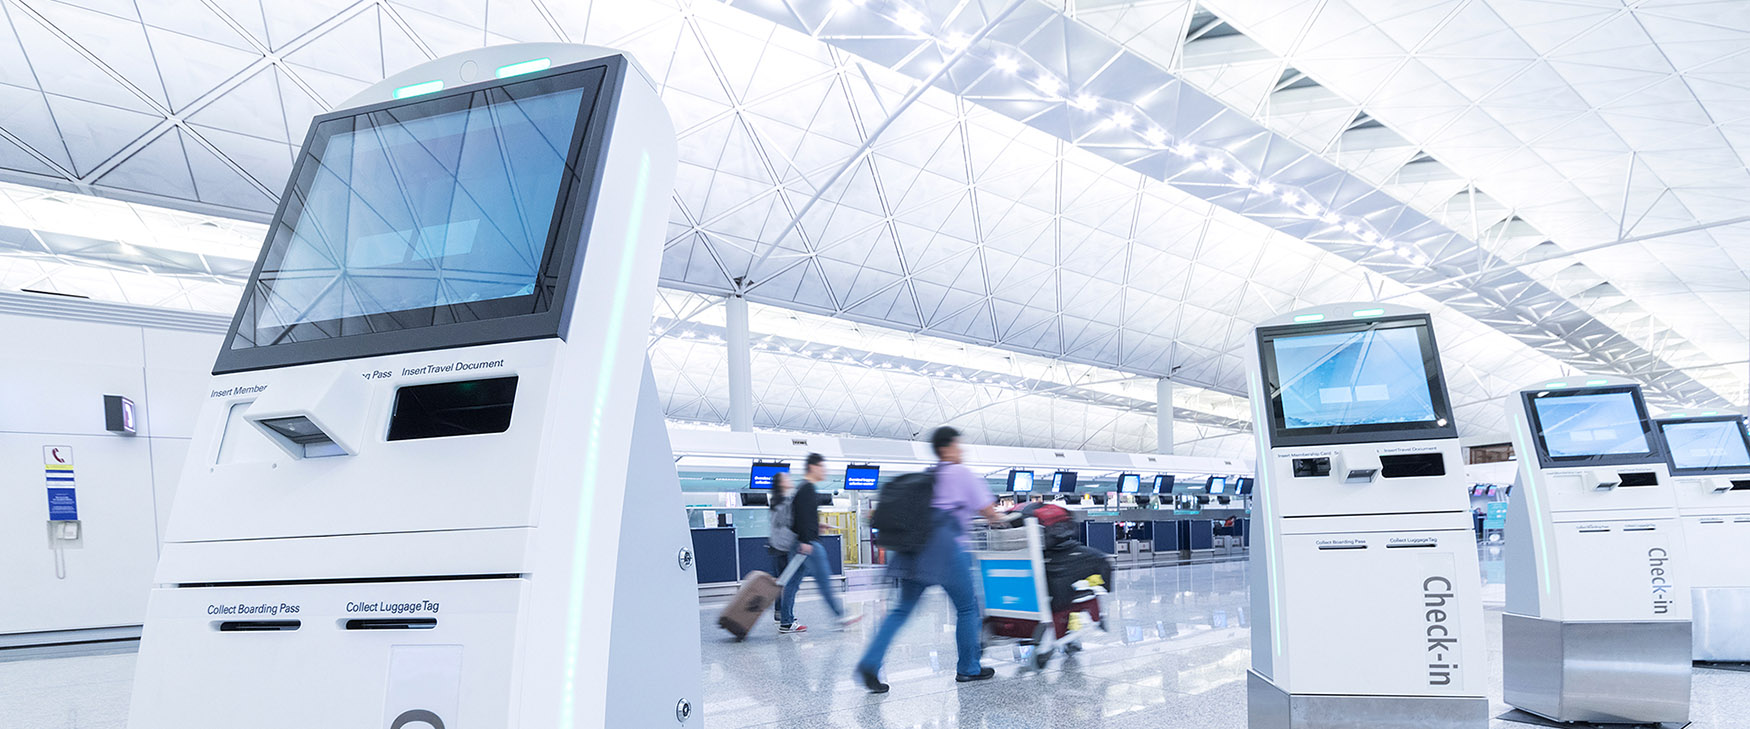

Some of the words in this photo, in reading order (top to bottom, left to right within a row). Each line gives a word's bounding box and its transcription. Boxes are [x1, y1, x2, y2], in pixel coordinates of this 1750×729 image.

[372, 370, 392, 379] Pass
[401, 367, 427, 377] Insert
[427, 363, 454, 374] Travel
[455, 359, 504, 371] Document
[210, 389, 233, 398] Insert
[1648, 547, 1673, 614] Check-in
[207, 604, 237, 615] Collect
[237, 603, 278, 616] Boarding
[279, 603, 300, 614] Pass
[346, 601, 378, 613] Collect
[379, 601, 422, 614] Luggage
[422, 600, 440, 613] Tag
[1423, 576, 1459, 685] Check-in
